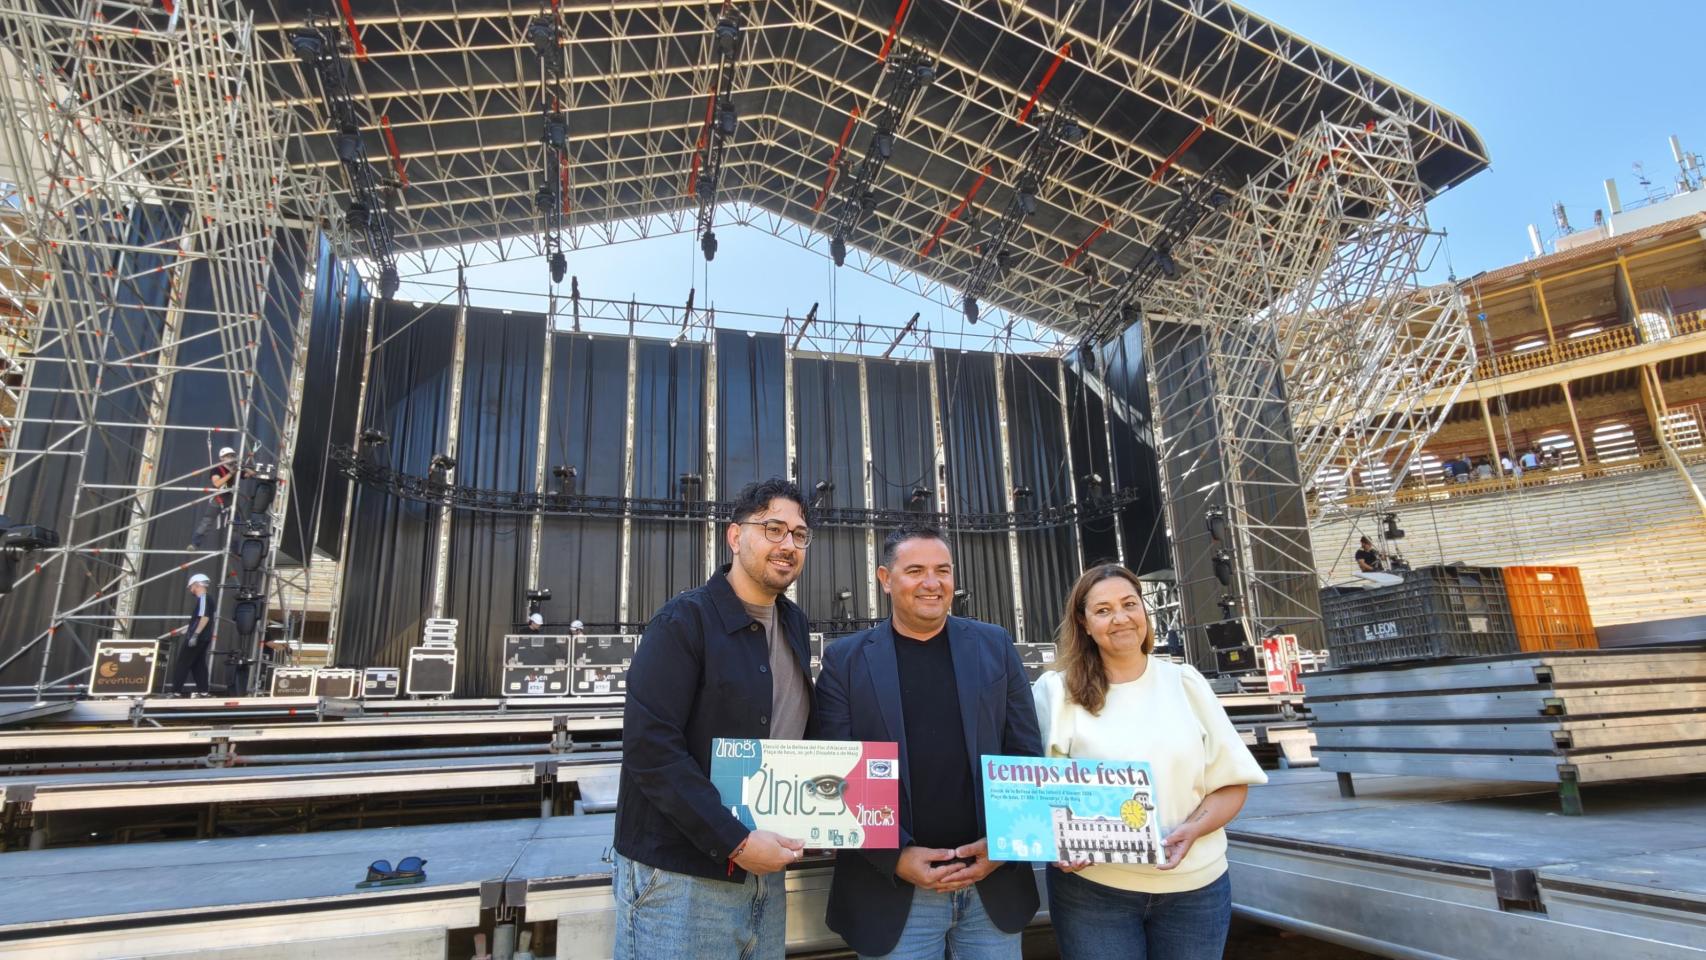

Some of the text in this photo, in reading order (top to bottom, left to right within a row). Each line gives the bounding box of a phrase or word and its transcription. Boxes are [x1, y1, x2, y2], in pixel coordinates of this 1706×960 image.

[97, 675, 147, 686] eventual
[277, 686, 307, 694] eventual
[987, 759, 1150, 788] temps de festa
